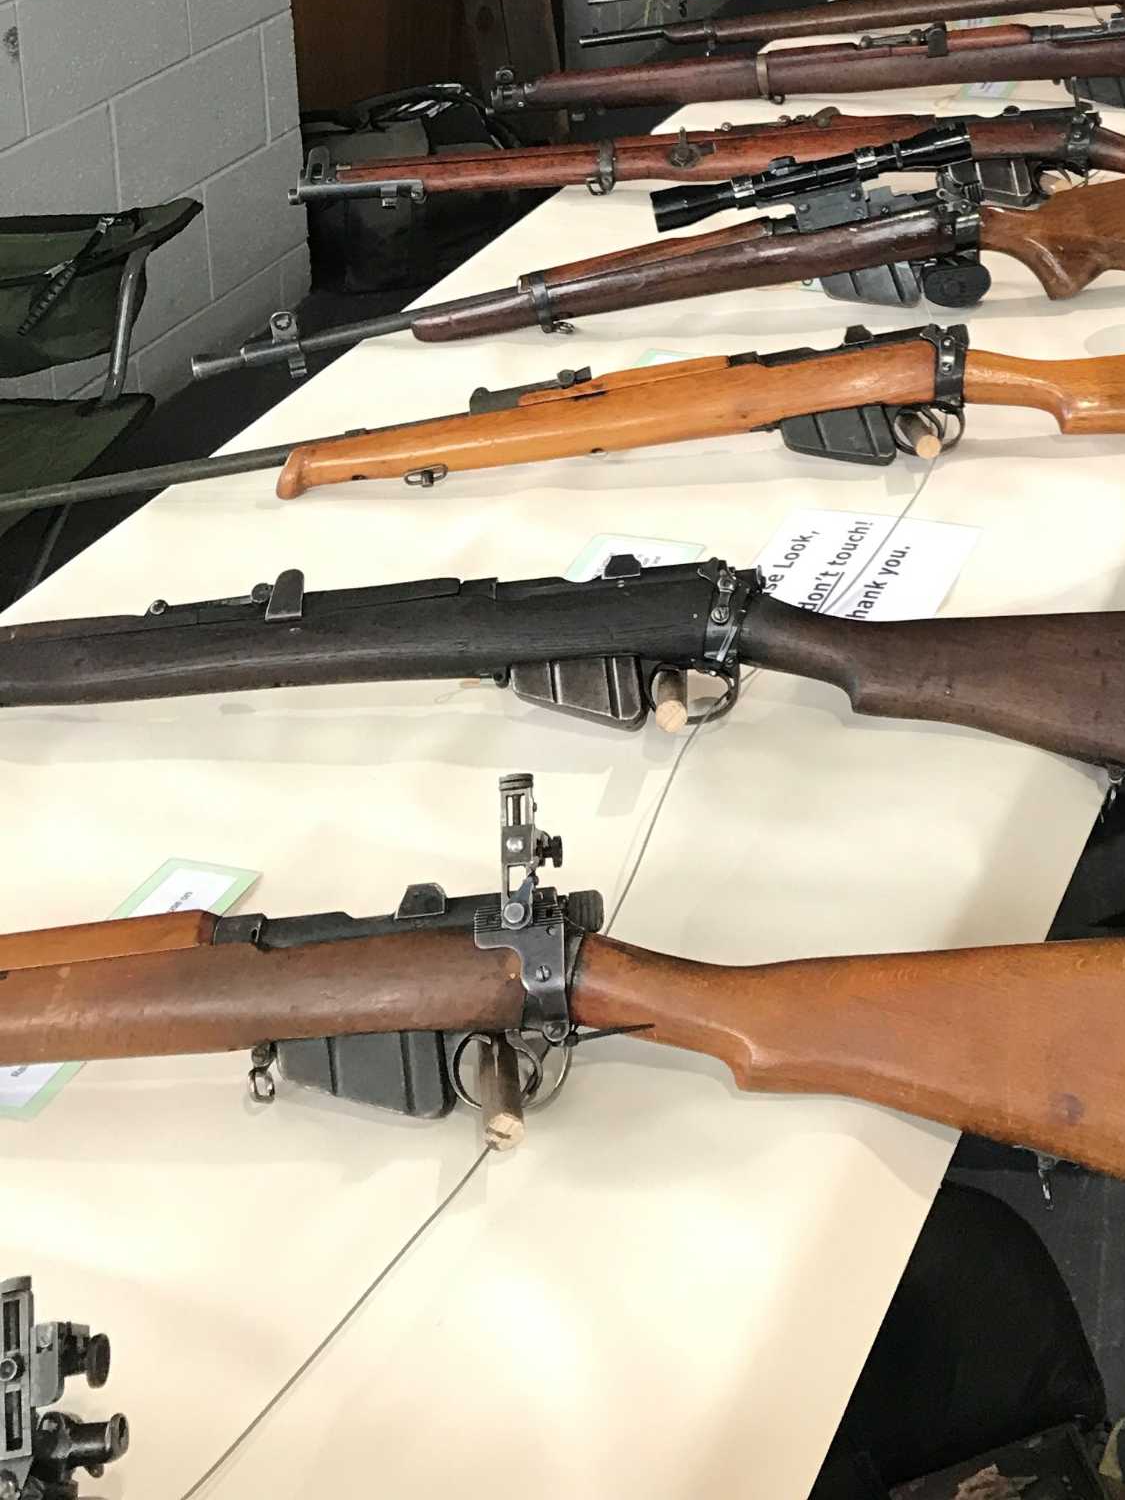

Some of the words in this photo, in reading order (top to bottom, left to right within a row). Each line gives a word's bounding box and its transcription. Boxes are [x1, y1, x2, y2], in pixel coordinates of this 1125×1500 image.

[773, 530, 820, 569] Look,
[828, 521, 874, 567] touch!
[846, 580, 887, 619] hank
[878, 546, 911, 577] you.
